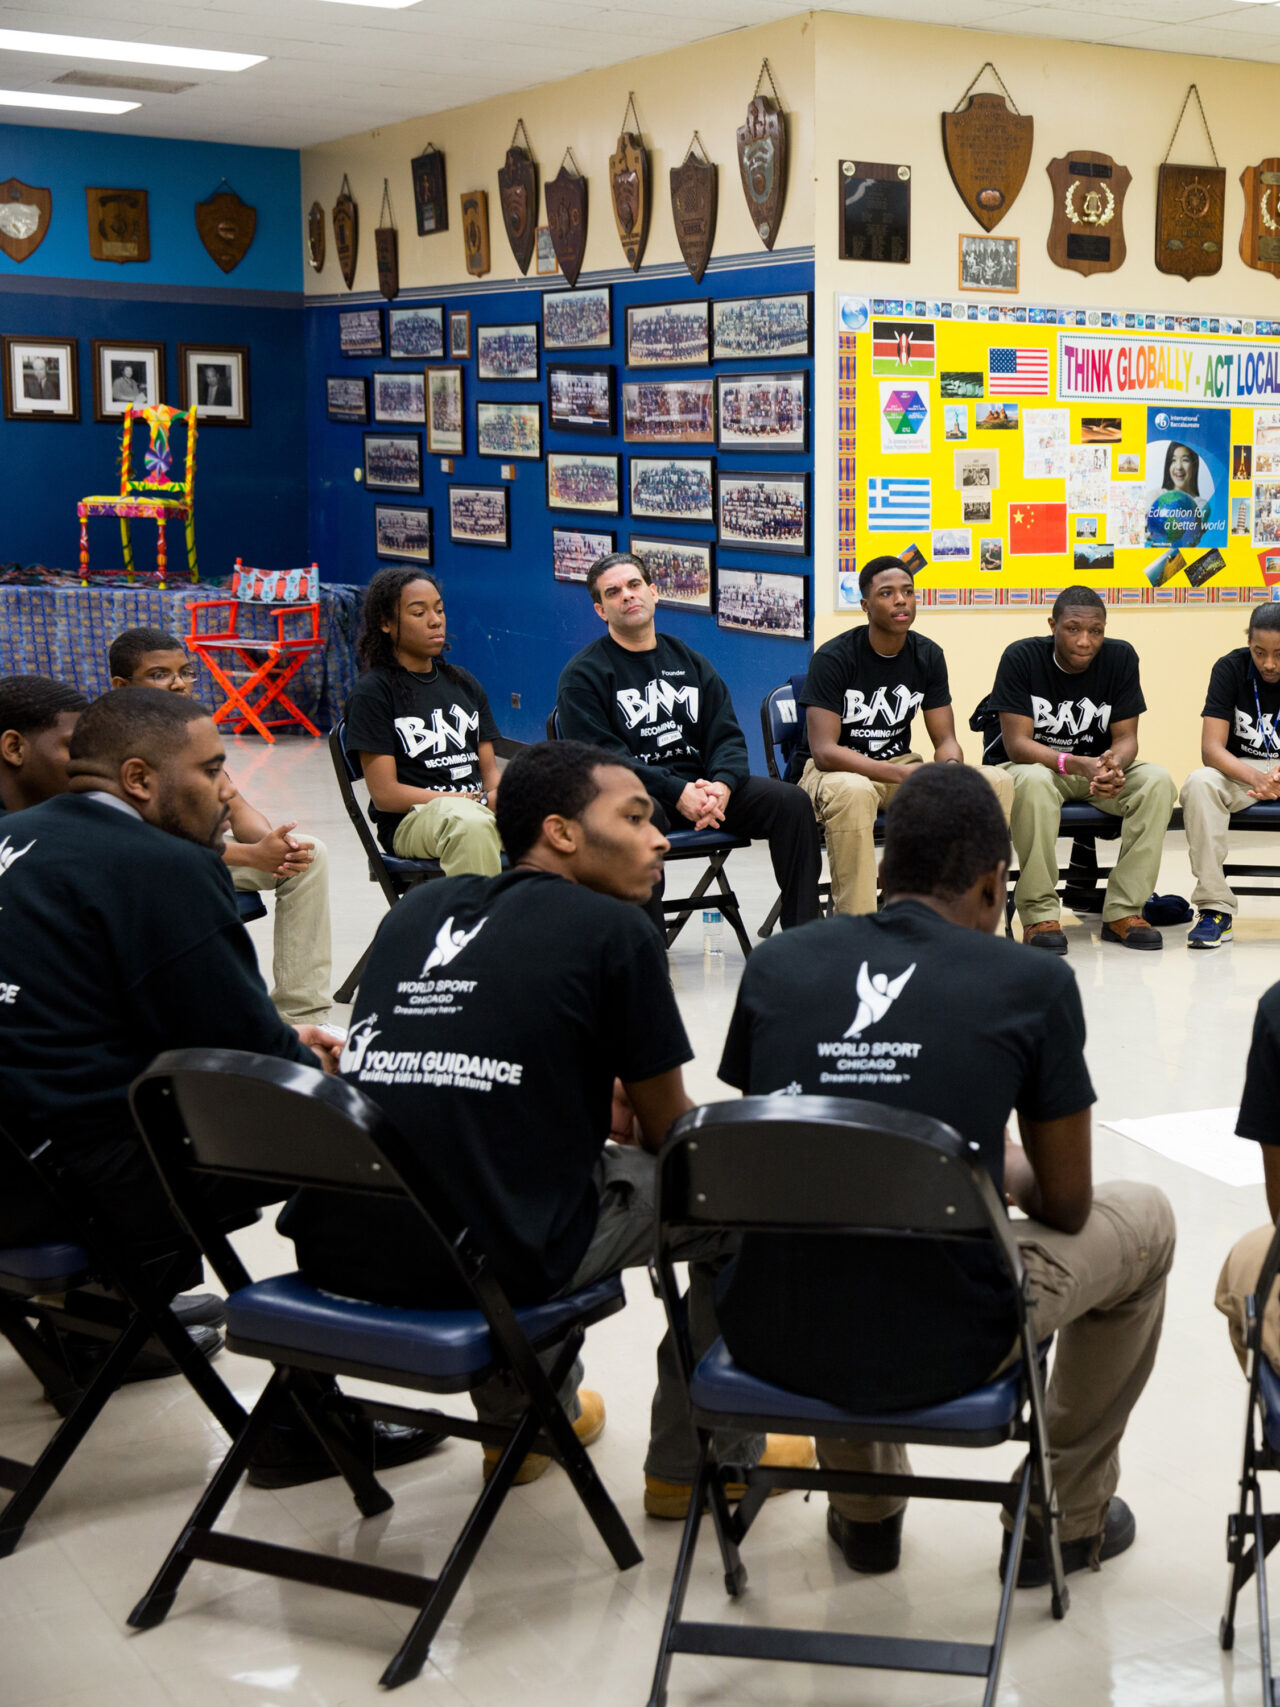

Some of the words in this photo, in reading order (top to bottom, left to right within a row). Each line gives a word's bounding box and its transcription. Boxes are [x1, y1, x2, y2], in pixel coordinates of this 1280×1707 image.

[1064, 344, 1114, 393] THINK
[1117, 344, 1194, 394] GLOBALLY
[1203, 354, 1234, 398] ACT
[1194, 506, 1207, 520] for
[1164, 521, 1171, 530] a
[1172, 519, 1198, 530] better
[1201, 519, 1226, 531] world
[616, 678, 699, 730] BAM
[840, 684, 926, 726] BAM
[1030, 694, 1113, 736] BAM
[393, 703, 481, 759] BAM
[640, 719, 677, 737] BECOMING
[850, 728, 891, 738] BECOMING
[1240, 743, 1279, 759] BECOMNG
[424, 752, 468, 769] BECOMING
[397, 980, 435, 994] WORLD
[435, 979, 478, 994] SPORT
[408, 993, 454, 1006] CHICAGO
[393, 1005, 423, 1015] Dreams
[423, 1005, 440, 1017] play
[817, 1042, 870, 1058] WORLD
[872, 1042, 922, 1059] SPORT
[364, 1050, 422, 1072] YOUTH
[421, 1050, 524, 1086] GUIDANCE
[836, 1058, 897, 1071] CHICAGO
[358, 1068, 395, 1086] Guiding
[394, 1070, 412, 1084] kids
[412, 1072, 422, 1084] to
[422, 1070, 453, 1089] bright
[453, 1075, 493, 1093] futures
[819, 1072, 857, 1084] Dreams
[858, 1072, 879, 1085] play
